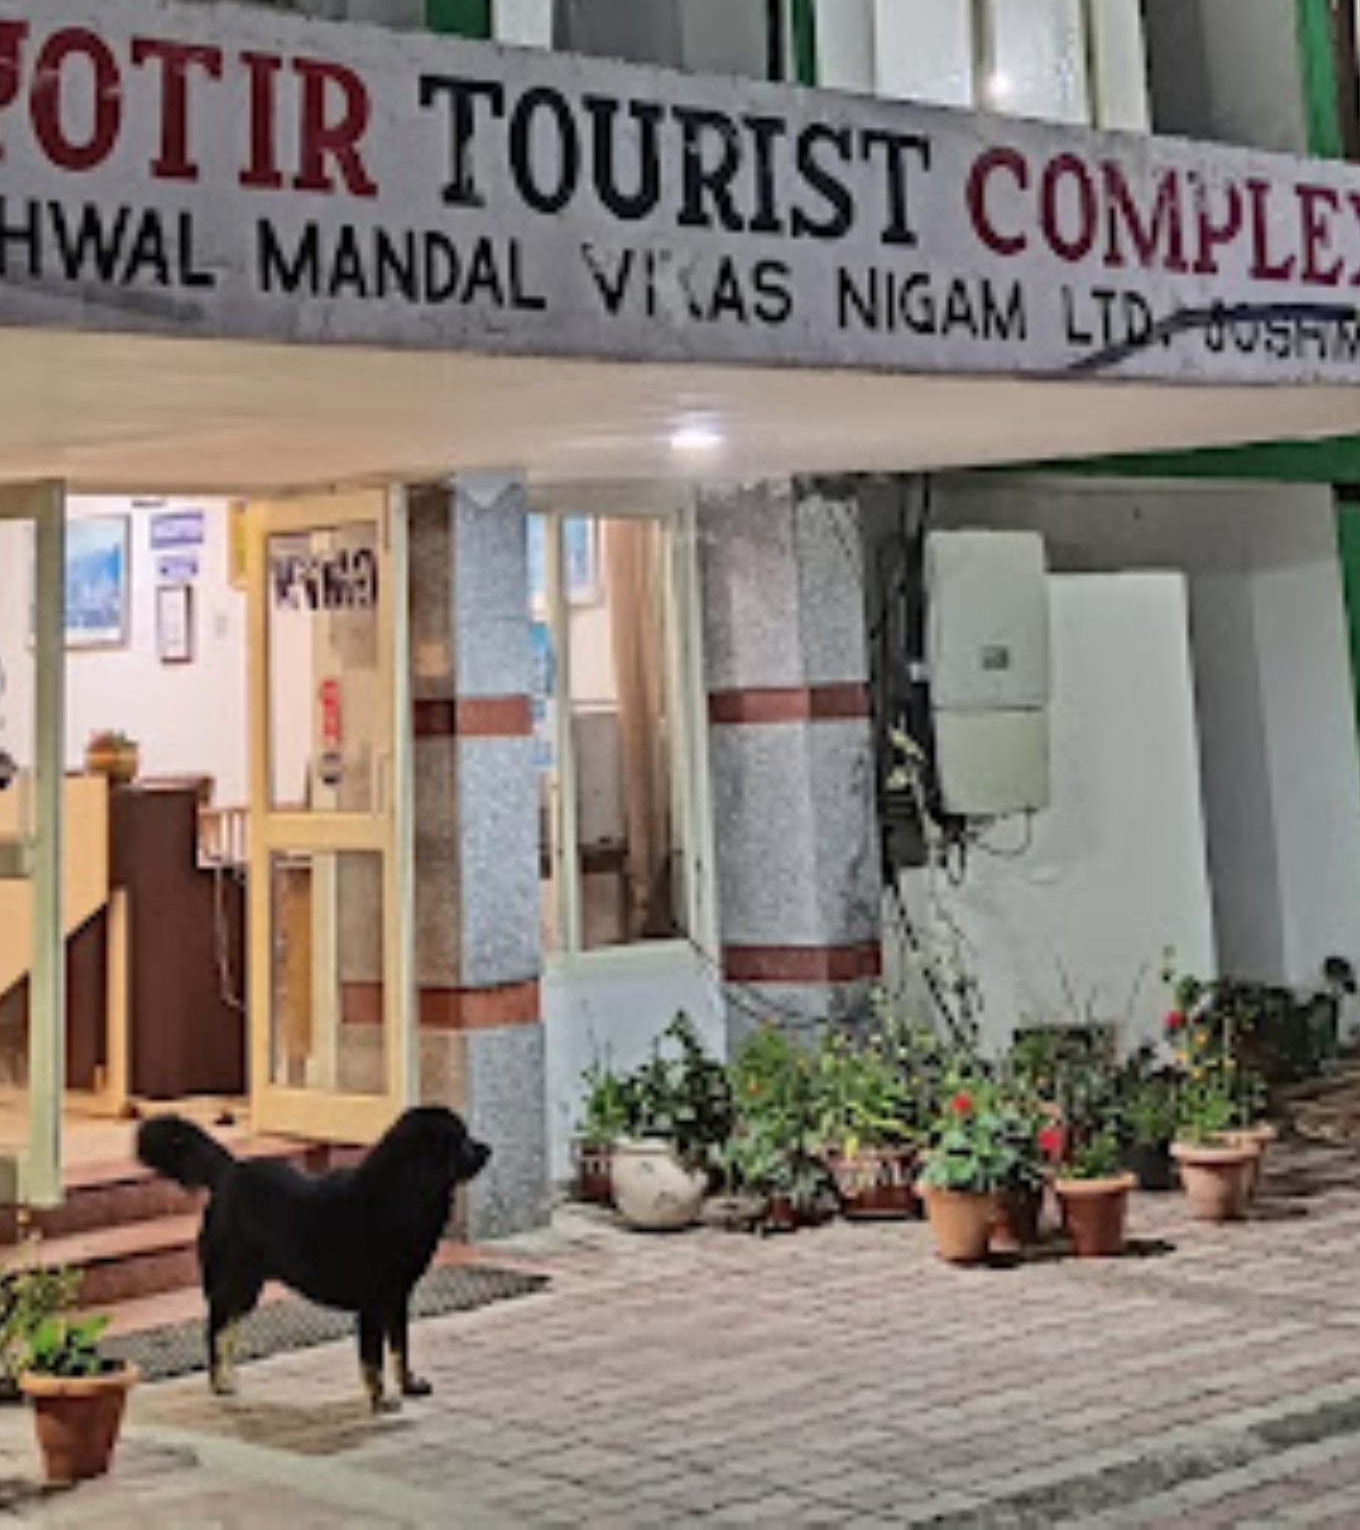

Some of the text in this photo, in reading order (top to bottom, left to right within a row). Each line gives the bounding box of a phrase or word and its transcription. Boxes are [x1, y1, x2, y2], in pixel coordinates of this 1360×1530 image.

[420, 74, 930, 247] TOURIST
[257, 218, 547, 312] MANDAL
[838, 265, 1028, 342] NIGAM
